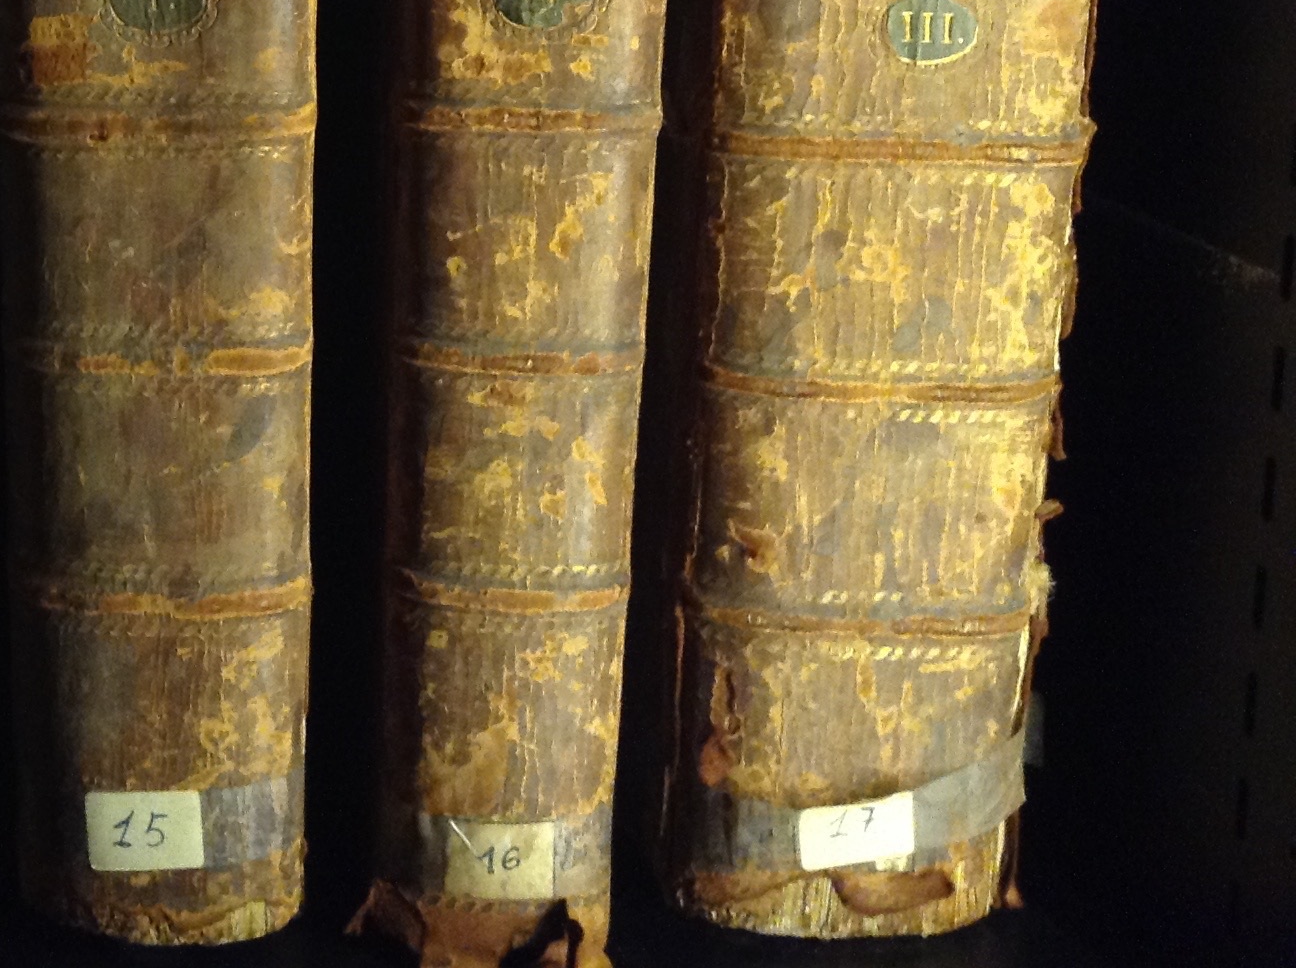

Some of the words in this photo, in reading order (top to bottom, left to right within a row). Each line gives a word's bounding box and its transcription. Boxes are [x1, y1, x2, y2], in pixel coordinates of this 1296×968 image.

[113, 810, 168, 848] 15
[829, 806, 875, 838] 17
[477, 845, 521, 874] 16
